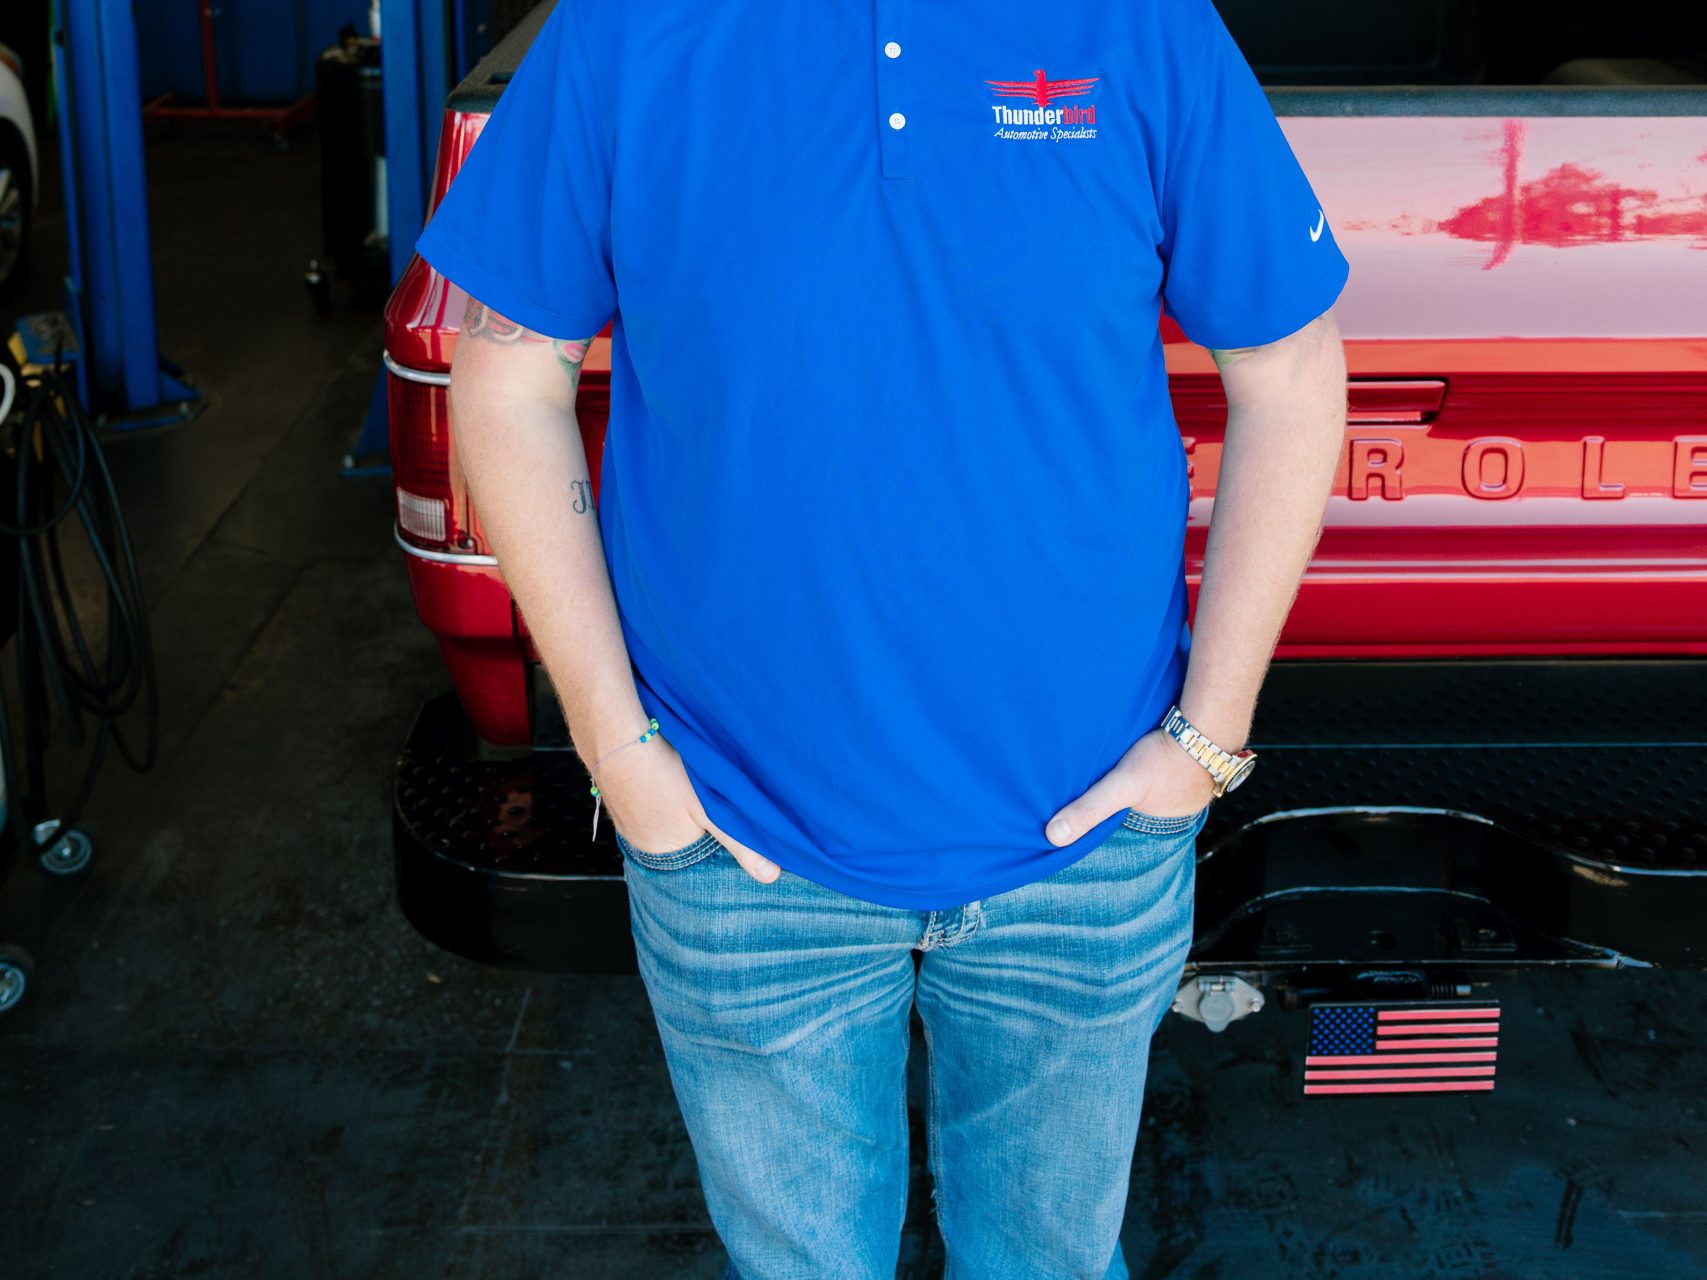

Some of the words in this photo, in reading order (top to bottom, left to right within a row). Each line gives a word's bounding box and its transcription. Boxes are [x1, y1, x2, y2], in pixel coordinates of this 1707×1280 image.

[991, 104, 1096, 125] Thunderbird
[993, 126, 1048, 140] Automotive
[1050, 126, 1098, 143] Specialists
[1182, 435, 1707, 500] ROLE
